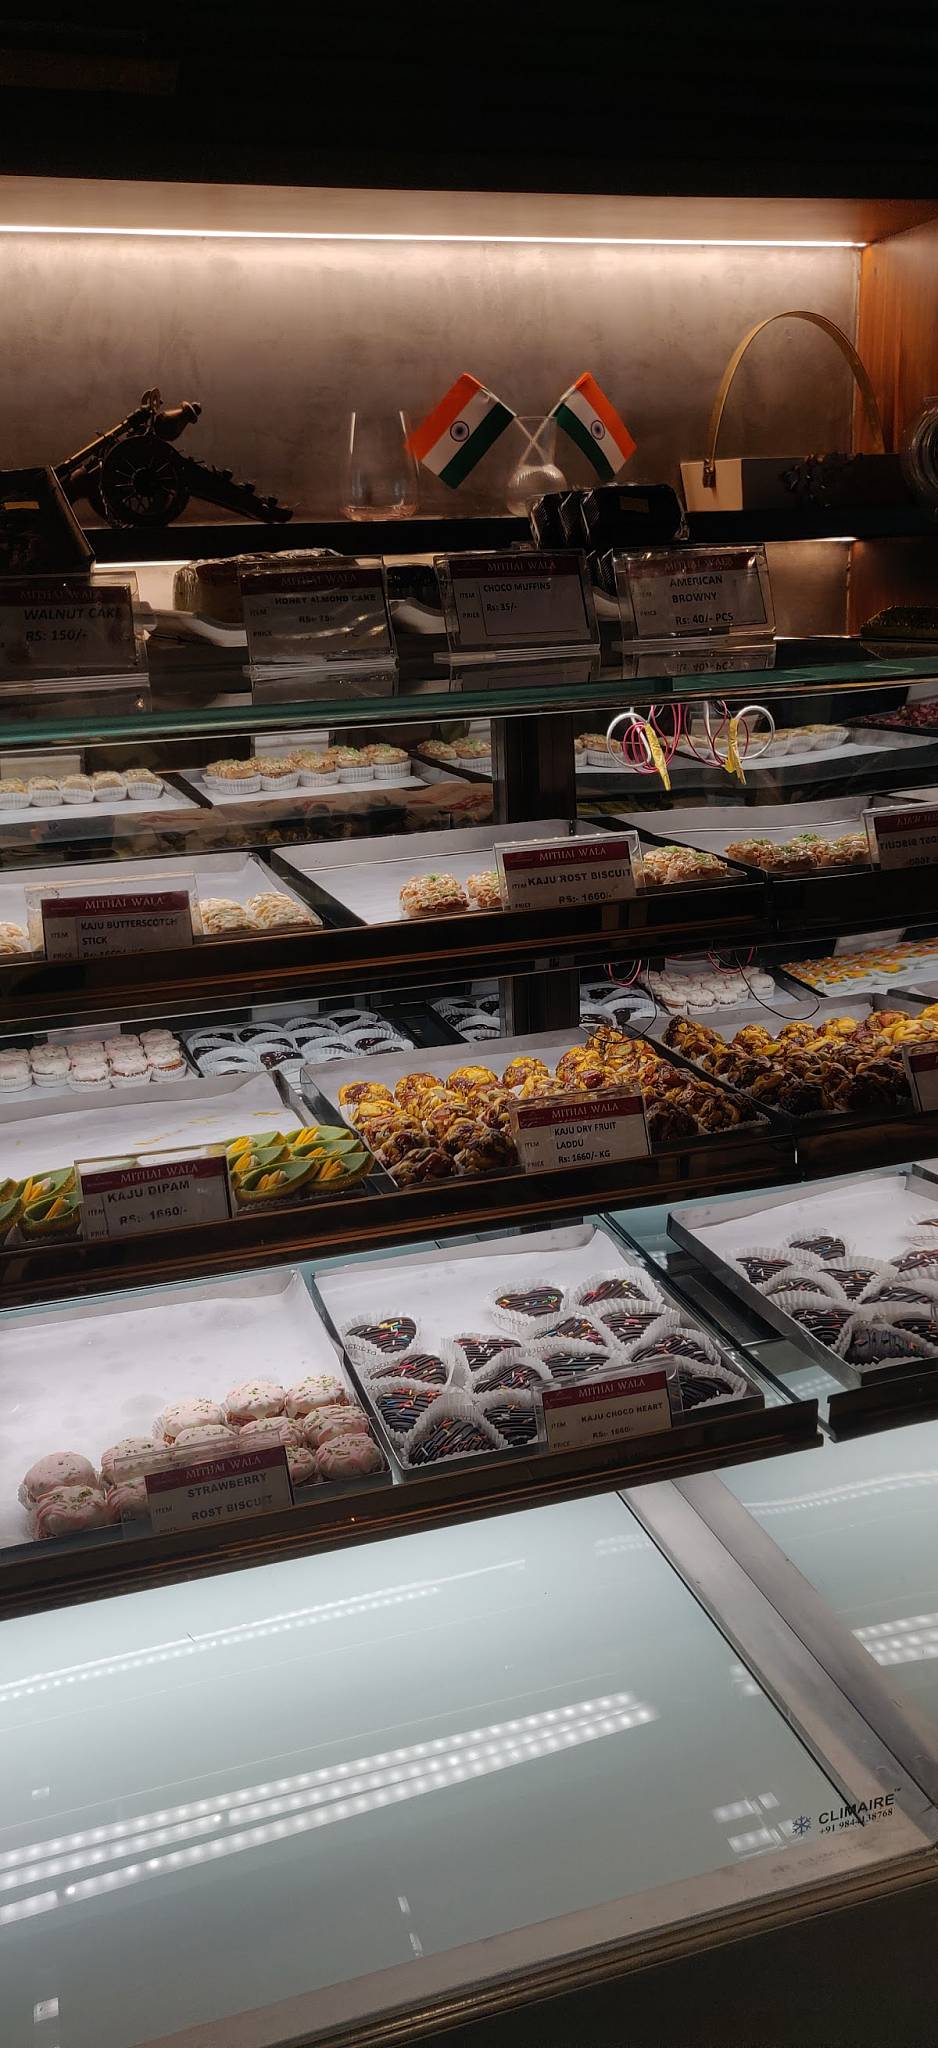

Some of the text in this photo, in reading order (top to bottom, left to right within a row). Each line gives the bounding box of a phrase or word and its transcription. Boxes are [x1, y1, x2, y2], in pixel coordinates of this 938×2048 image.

[528, 559, 557, 569] WALA
[483, 582, 551, 592] CHOCO MUFFINS
[670, 576, 722, 587] AMERICAN
[672, 592, 717, 603] BROWNY
[24, 606, 121, 620] WALNUT CAKE
[500, 602, 517, 612] 35/-
[676, 612, 734, 625] Rs: 40/- PCS
[26, 629, 87, 641] RS: 150/-
[540, 847, 607, 862] MITHAI WALA
[528, 869, 631, 886] KAJU ROST BISCUIT
[85, 896, 163, 910] MITHAI WALA
[81, 918, 177, 931] KAJU BUTTERSCOTCH
[82, 936, 108, 946] STICK
[552, 1103, 619, 1120] MITHAI WALA
[554, 1122, 616, 1136] KAJU DRY FRUIT
[556, 1140, 584, 1150] LADDU
[572, 1151, 598, 1161] 1660/-
[599, 1150, 610, 1158] KG
[120, 1163, 199, 1184] MITHAI WALA
[108, 1181, 190, 1203] KAJU DIPAM
[578, 1377, 646, 1398] MITHAI WALA
[581, 1402, 663, 1423] KAJU CHOCO HEART
[185, 1456, 262, 1480] MITHAI WALA
[188, 1473, 267, 1498] STRAWBERRY
[192, 1495, 272, 1521] ROST BISCUIT
[819, 1794, 894, 1824] CLIMAIRE
[821, 1825, 835, 1833] +91
